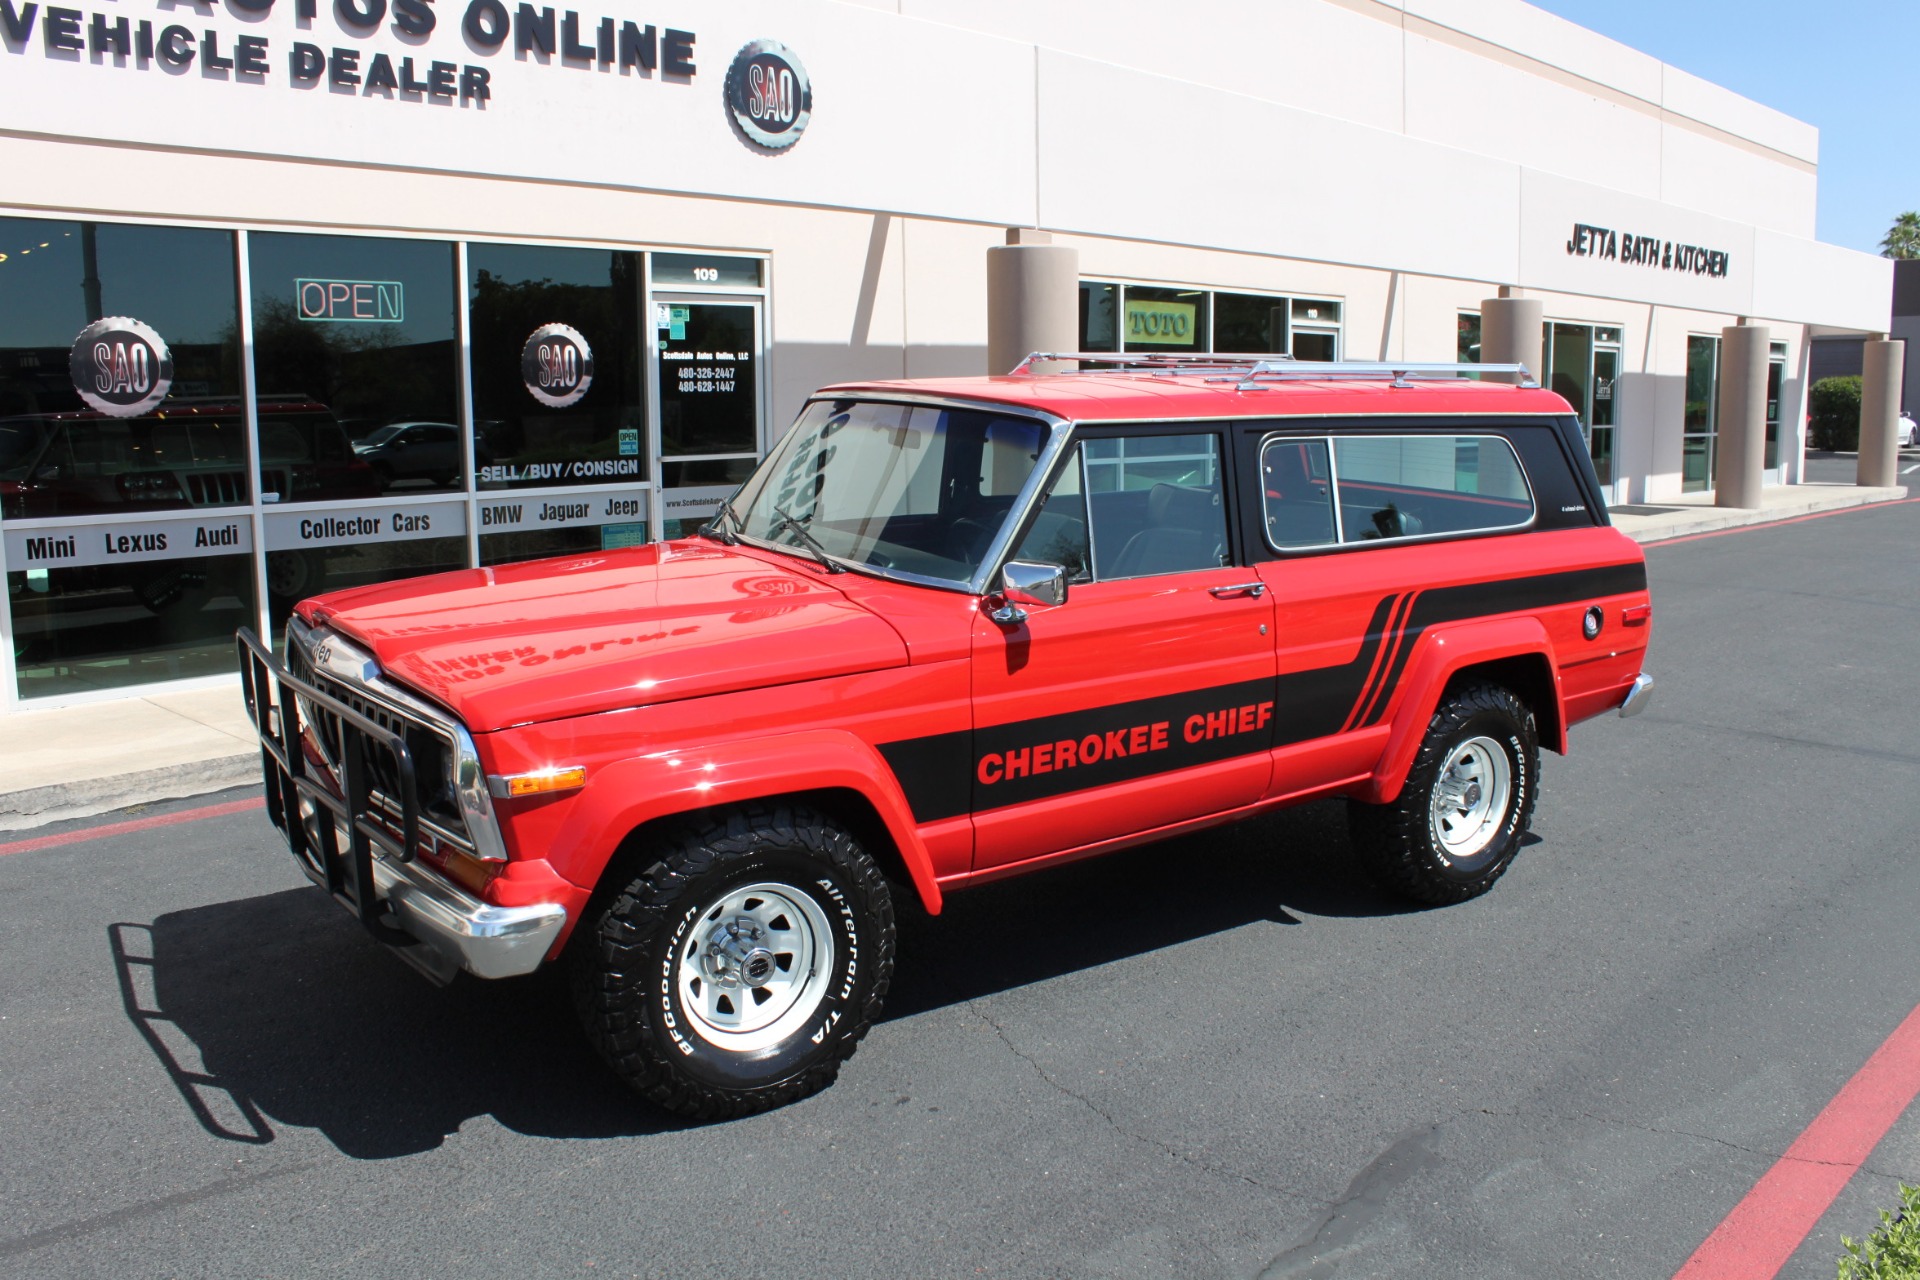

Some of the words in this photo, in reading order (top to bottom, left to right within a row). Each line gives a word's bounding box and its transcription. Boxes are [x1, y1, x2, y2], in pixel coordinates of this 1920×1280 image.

[0, 1, 270, 74] VEHICLE
[292, 41, 492, 101] DEALER
[466, 0, 697, 76] ONLINE
[749, 63, 794, 124] SAO
[1567, 223, 1616, 260] JETTA
[1621, 233, 1661, 267] BATH
[1662, 241, 1672, 269] &
[1674, 243, 1729, 278] KITCHEN
[693, 267, 719, 281] 109
[301, 282, 401, 318] OPEN
[1128, 309, 1190, 337] TOTO
[93, 341, 150, 394] SAO
[537, 344, 577, 388] SAO
[662, 351, 694, 360] Scottsdale
[737, 352, 749, 360] LLC
[678, 367, 736, 379] 480-326-2447
[678, 381, 736, 393] 480-628-1447
[619, 432, 637, 443] OPEN
[300, 515, 381, 540] Collector
[392, 511, 431, 533] Cars
[481, 504, 523, 526] BMW
[539, 501, 590, 521] Jaguar
[605, 498, 639, 516] Jeep
[26, 534, 76, 561] Mini
[105, 529, 168, 555] Lexus
[195, 524, 239, 548] Audi
[977, 720, 1170, 785] CHEROKEE
[1183, 701, 1274, 744] CHIEF
[816, 878, 858, 1000] All-Terrain
[661, 905, 697, 1056] BFGoodrich
[811, 1009, 842, 1045] T/A
